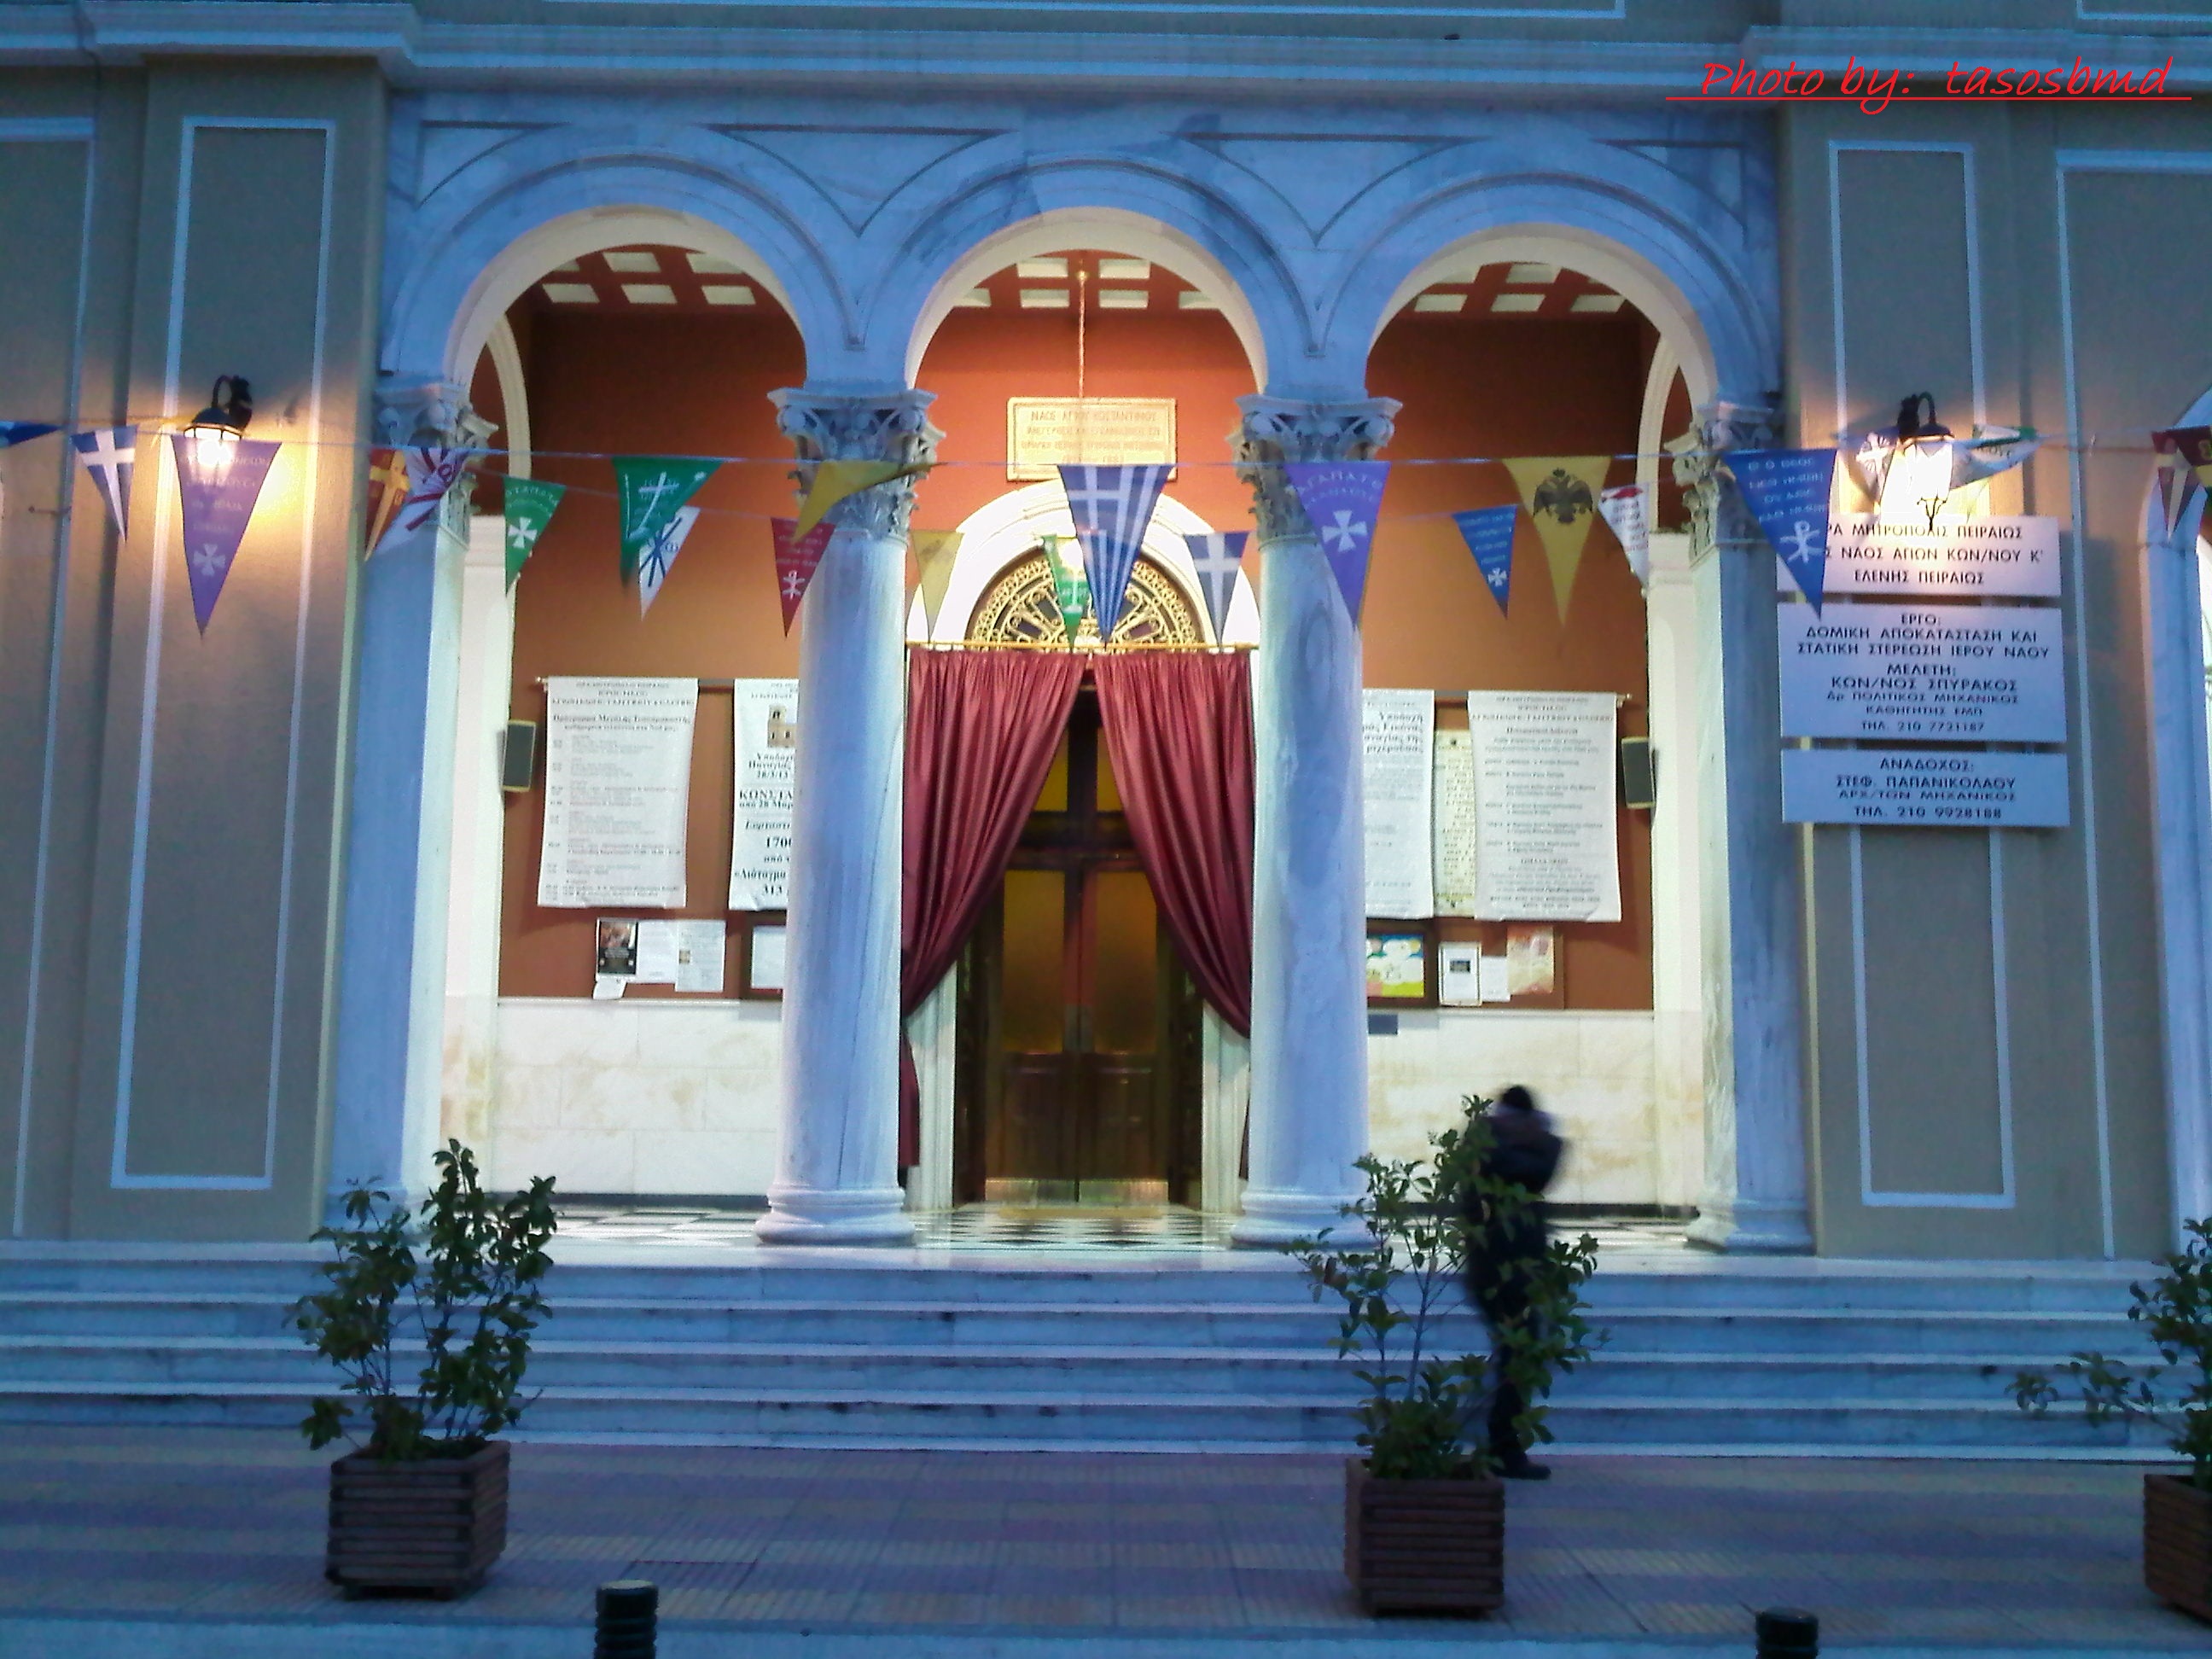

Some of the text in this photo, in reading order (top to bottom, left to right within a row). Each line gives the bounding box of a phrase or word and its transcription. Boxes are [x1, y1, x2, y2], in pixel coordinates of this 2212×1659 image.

[1852, 523, 1949, 538] ΜΗΤΡΟΠΟΛΙΣ
[1957, 526, 2023, 539] ΠΕΙΡΑΙΩΣ
[1842, 547, 1883, 559] ΝΑΟΣ
[1893, 548, 1937, 561] ΑΓΙΩΝ
[1947, 549, 2021, 563] ΚΩΝ/ΝΟΥ
[1854, 569, 1984, 585] ΕΛΕΝΗΣ ΠΕΙΡΑΙΩΣ
[1901, 613, 1941, 626] ΕΡΓΟ:
[1807, 626, 2037, 643] ΔΟΜΙΚΗ ΑΠΟΚΑΤΑΣΤΑΣΗ ΚΑΙ
[1797, 643, 2049, 660] ΣΤΑΤΙΚΗ ΣΤΕΡΕΩΣΗ ΙΕΡΟΥ ΝΑΟΥ
[1887, 664, 1956, 677] ΜΕΛΕΤΗ:
[1831, 677, 2017, 692] ΚΩΝ/ΝΟΣ ΣΠΥΡΑΚΟΣ
[1853, 692, 1925, 701] ΠΟΛΙΤΙΚΟΣ
[1934, 694, 2018, 704] ΜΗΧΑΝΙΚΟΣ
[1866, 706, 1946, 716] ΚΑΘΗΓΗΤΗΣ
[1898, 721, 1922, 731] 210
[1886, 777, 2016, 789] ΠΑΠΑΝΙΚΟΛΑΟΥ
[1920, 790, 2016, 801] ΜΗΧΑΝΙΚΟΣ
[1896, 806, 1926, 818] 210
